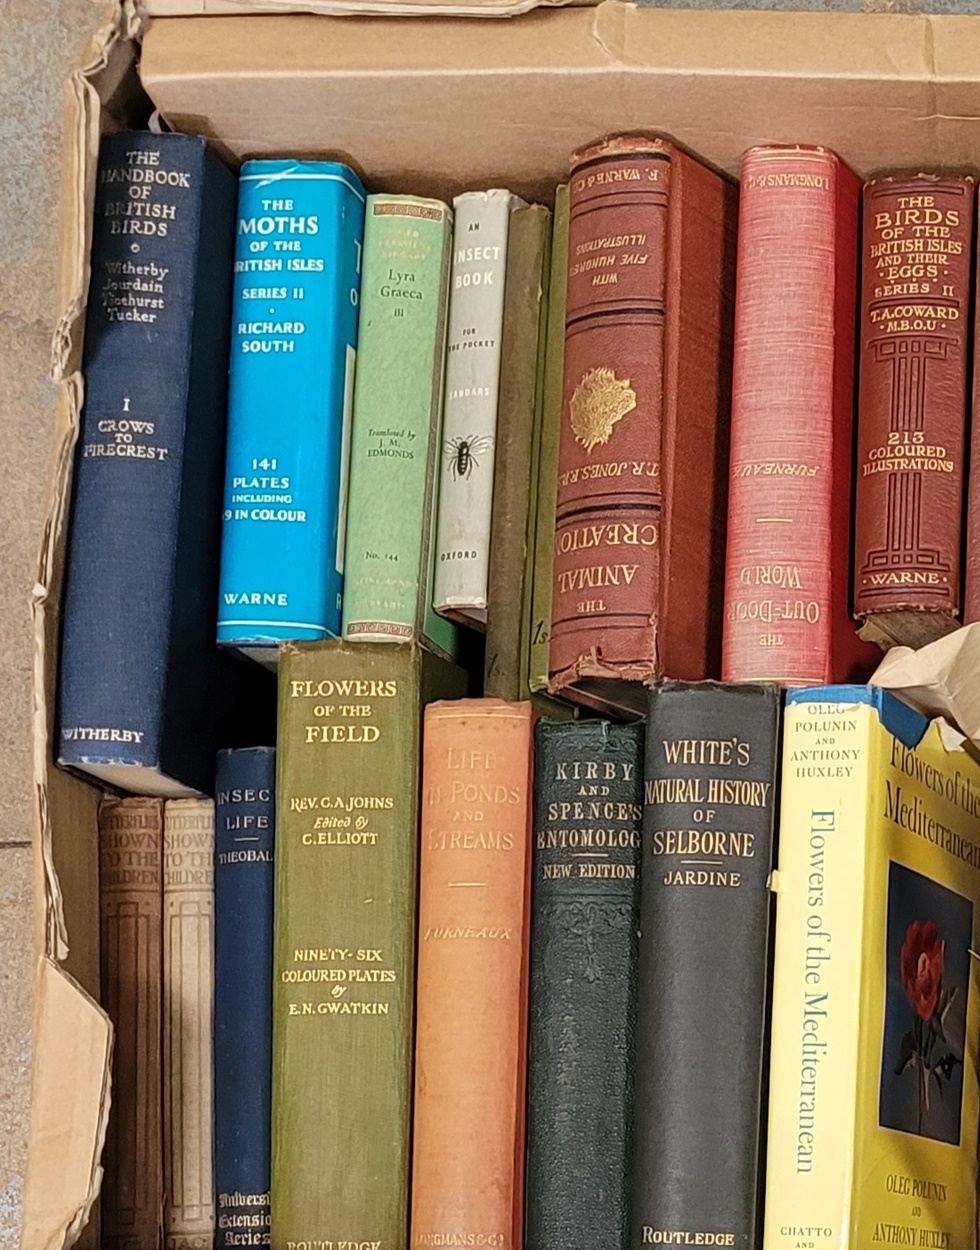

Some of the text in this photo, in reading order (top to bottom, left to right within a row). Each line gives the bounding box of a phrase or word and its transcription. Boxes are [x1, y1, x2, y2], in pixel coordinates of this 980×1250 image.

[262, 200, 293, 211] THE
[111, 221, 168, 236] BIRDS
[239, 217, 318, 235] MOTHS
[469, 223, 480, 232] AN
[250, 241, 301, 252] OF THE
[870, 241, 963, 258] BRITISH ISLES
[389, 269, 415, 285] Lyra
[592, 273, 618, 286] WITH
[888, 266, 938, 280] EGGS
[456, 272, 493, 289] BOOK
[242, 288, 287, 299] SERIES
[381, 286, 423, 300] Graeca
[238, 322, 304, 334] RICHARD
[242, 341, 294, 352] SOUTH
[98, 421, 154, 434] CROWS
[888, 432, 924, 445] 213
[84, 445, 168, 461] FIRECREST
[368, 449, 414, 459] EDMONDS
[869, 446, 946, 459] COLOURED
[252, 458, 277, 470] 141
[233, 478, 289, 489] PLATES
[441, 551, 477, 561] OXFORD
[558, 564, 640, 592] ANIMAL
[740, 566, 802, 588] WORLD
[224, 594, 288, 606] WARNE
[760, 634, 784, 646] THE
[291, 680, 397, 697] FLOWERS
[314, 705, 372, 717] OF THE
[795, 721, 857, 732] POLUNIN
[62, 728, 144, 743] WITHERBY
[305, 726, 380, 743] FIELD
[663, 738, 750, 766] WHITE'S
[791, 750, 860, 761] ANTHONY
[555, 761, 634, 781] KIRBY
[796, 767, 853, 778] HUXLEY
[578, 785, 610, 796] AND
[707, 779, 771, 807] HISTORY
[693, 809, 715, 823] OF
[226, 816, 268, 830] LIFE
[653, 831, 755, 857] SELBORNE
[579, 864, 636, 879] EDITION
[664, 871, 741, 887] JARDINE
[348, 970, 396, 982] PLATES
[797, 809, 835, 1174] Flowers of the Mediterranean
[780, 1227, 832, 1237] CHATTO
